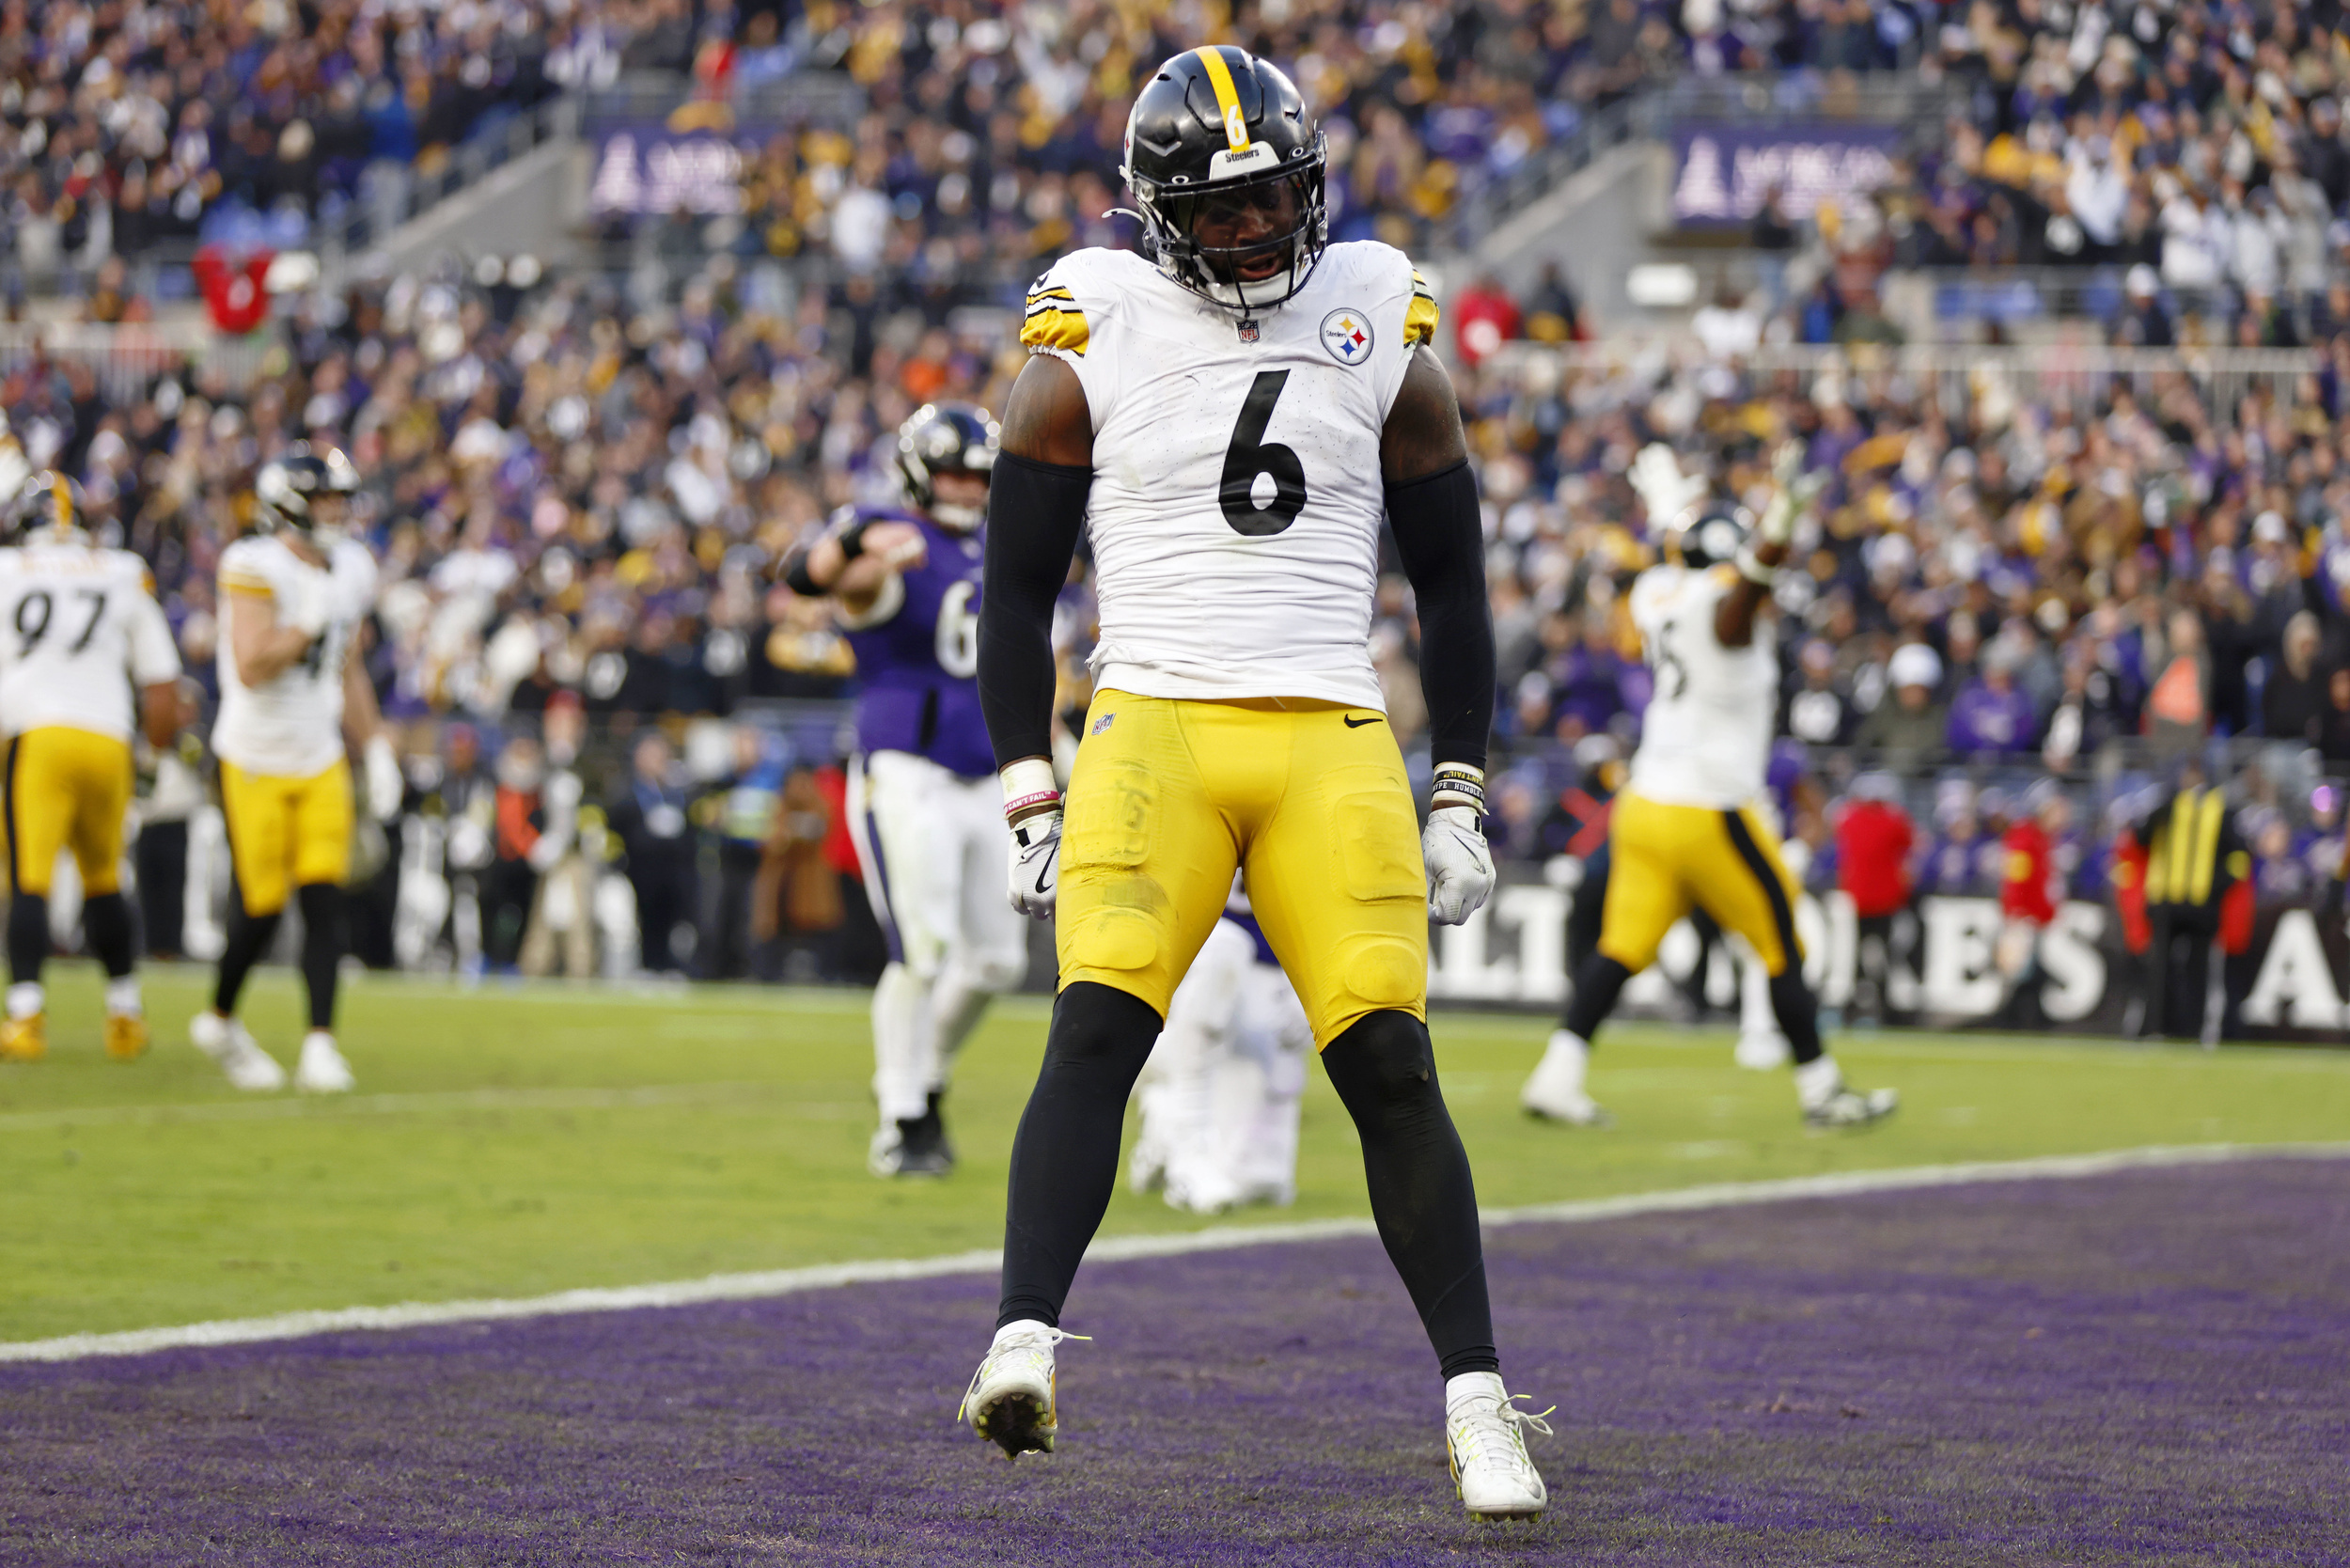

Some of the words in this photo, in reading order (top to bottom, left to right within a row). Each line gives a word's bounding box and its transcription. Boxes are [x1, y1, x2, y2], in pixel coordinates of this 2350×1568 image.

[1226, 104, 1247, 147] 6
[1225, 149, 1260, 163] Steelers
[1241, 329, 1258, 340] NFL
[1218, 368, 1308, 536] 6
[12, 586, 109, 660] 97
[1453, 782, 1480, 797] HUMBLE
[1008, 797, 1028, 810] CAN'T
